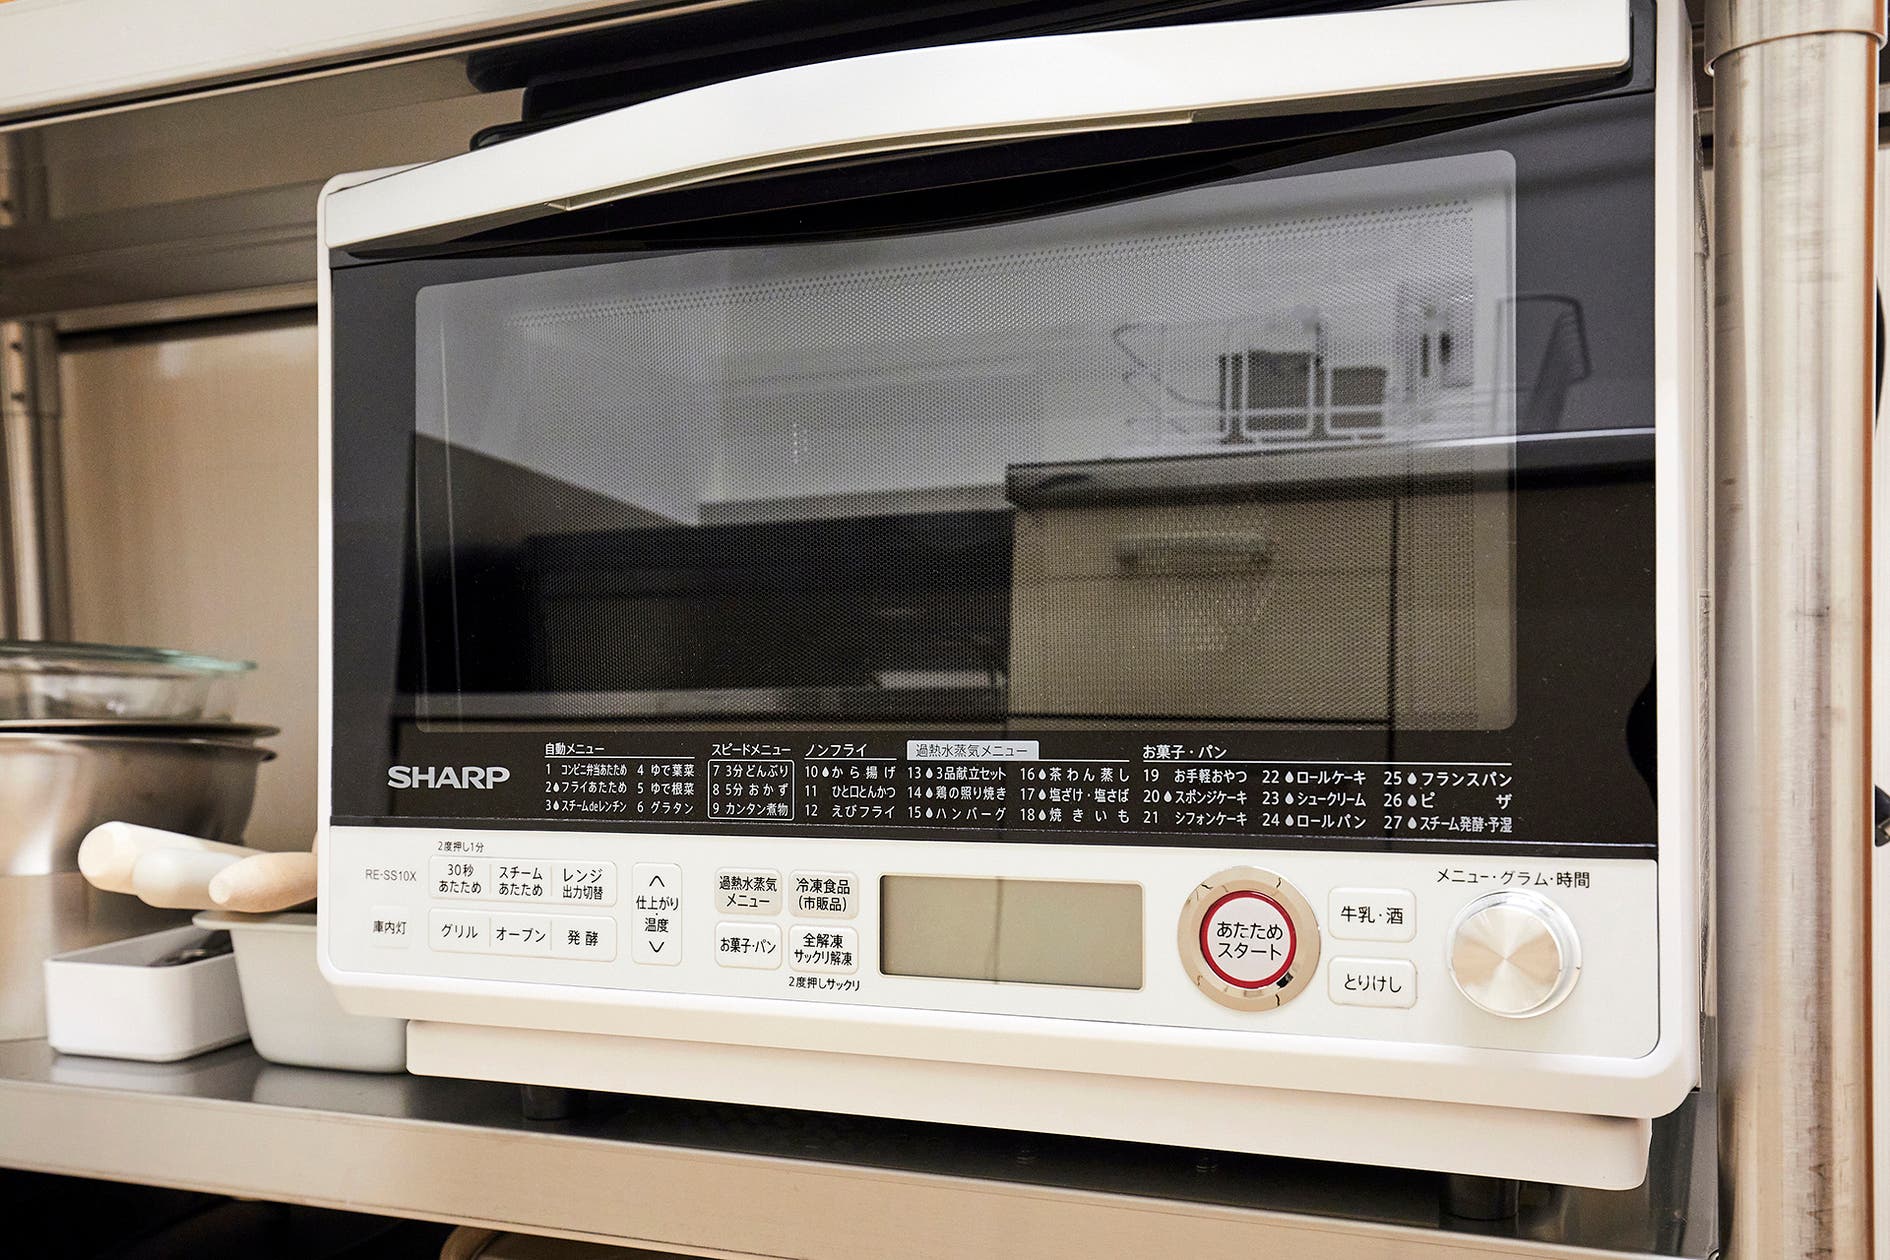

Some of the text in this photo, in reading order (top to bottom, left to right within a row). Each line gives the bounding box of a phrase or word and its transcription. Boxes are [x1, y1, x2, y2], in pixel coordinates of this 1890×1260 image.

[545, 743, 605, 755] 自動メニュー
[712, 743, 791, 756] スピードメニュー
[805, 744, 868, 757] ノンフライ
[915, 743, 1028, 759] 過熱水蒸気メニュー
[387, 765, 510, 789] SHARP
[545, 764, 627, 776] 1 コンビニ弁当あたため
[637, 764, 695, 777] 4 ゆで葉菜
[712, 765, 719, 777] 7
[804, 766, 818, 778] 10
[907, 767, 1006, 781] 13 3品献立セット
[1019, 768, 1034, 780] 16
[1143, 769, 1248, 783] 19 お手軽おやつ
[1262, 771, 1366, 785] 22 ロールケーキ
[1383, 771, 1512, 787] 25 フランスパン
[545, 782, 627, 794] 2 フライあたため
[637, 782, 695, 796] 5 ゆで根菜
[712, 783, 719, 795] 8
[804, 786, 896, 799] 11 ひと口とんかつ
[907, 786, 1007, 801] 14 鶏の照り焼き
[1019, 787, 1034, 800] 17
[1143, 790, 1248, 804] 20 スポンジケーキ
[1262, 792, 1367, 807] 23 シュークリーム
[1383, 794, 1401, 807] 26
[545, 799, 627, 814] 3 スチームdeレンチン
[637, 800, 694, 814] 6 グラタン
[712, 802, 789, 816] 9 カンタン煮物
[804, 805, 896, 819] 12 えびフライ
[907, 806, 1007, 821] 15 ハンバーグ
[1019, 808, 1034, 821] 18
[1143, 811, 1248, 826] 21 シフォンケーキ
[1262, 814, 1366, 828] 24 ロールパン
[1383, 816, 1401, 829] 27
[438, 841, 484, 853] 2度押し1分
[365, 869, 417, 882] RE-SS10X
[447, 863, 474, 876] 30秒
[499, 867, 543, 880] スチーム
[563, 868, 602, 883] レンジ
[439, 881, 482, 894] あたため
[499, 883, 543, 896] あたため
[719, 876, 777, 892] 過熱水蒸気
[795, 878, 851, 895] 冷凍食品
[563, 885, 603, 900] 出力切替
[636, 896, 679, 910] 仕上がり
[726, 894, 769, 908] メニュー
[798, 896, 847, 913] (市販品)
[373, 921, 406, 935] 庫内灯
[441, 924, 478, 939] グリル
[645, 918, 669, 933] 温度
[1217, 922, 1283, 940] あたため
[496, 928, 546, 943] オーブン
[802, 933, 843, 948] 全解凍
[794, 950, 853, 966] サックリ解凍
[1217, 943, 1283, 961] スタート
[788, 975, 860, 992] 2度押しサックリ
[1343, 974, 1402, 993] とりけし
